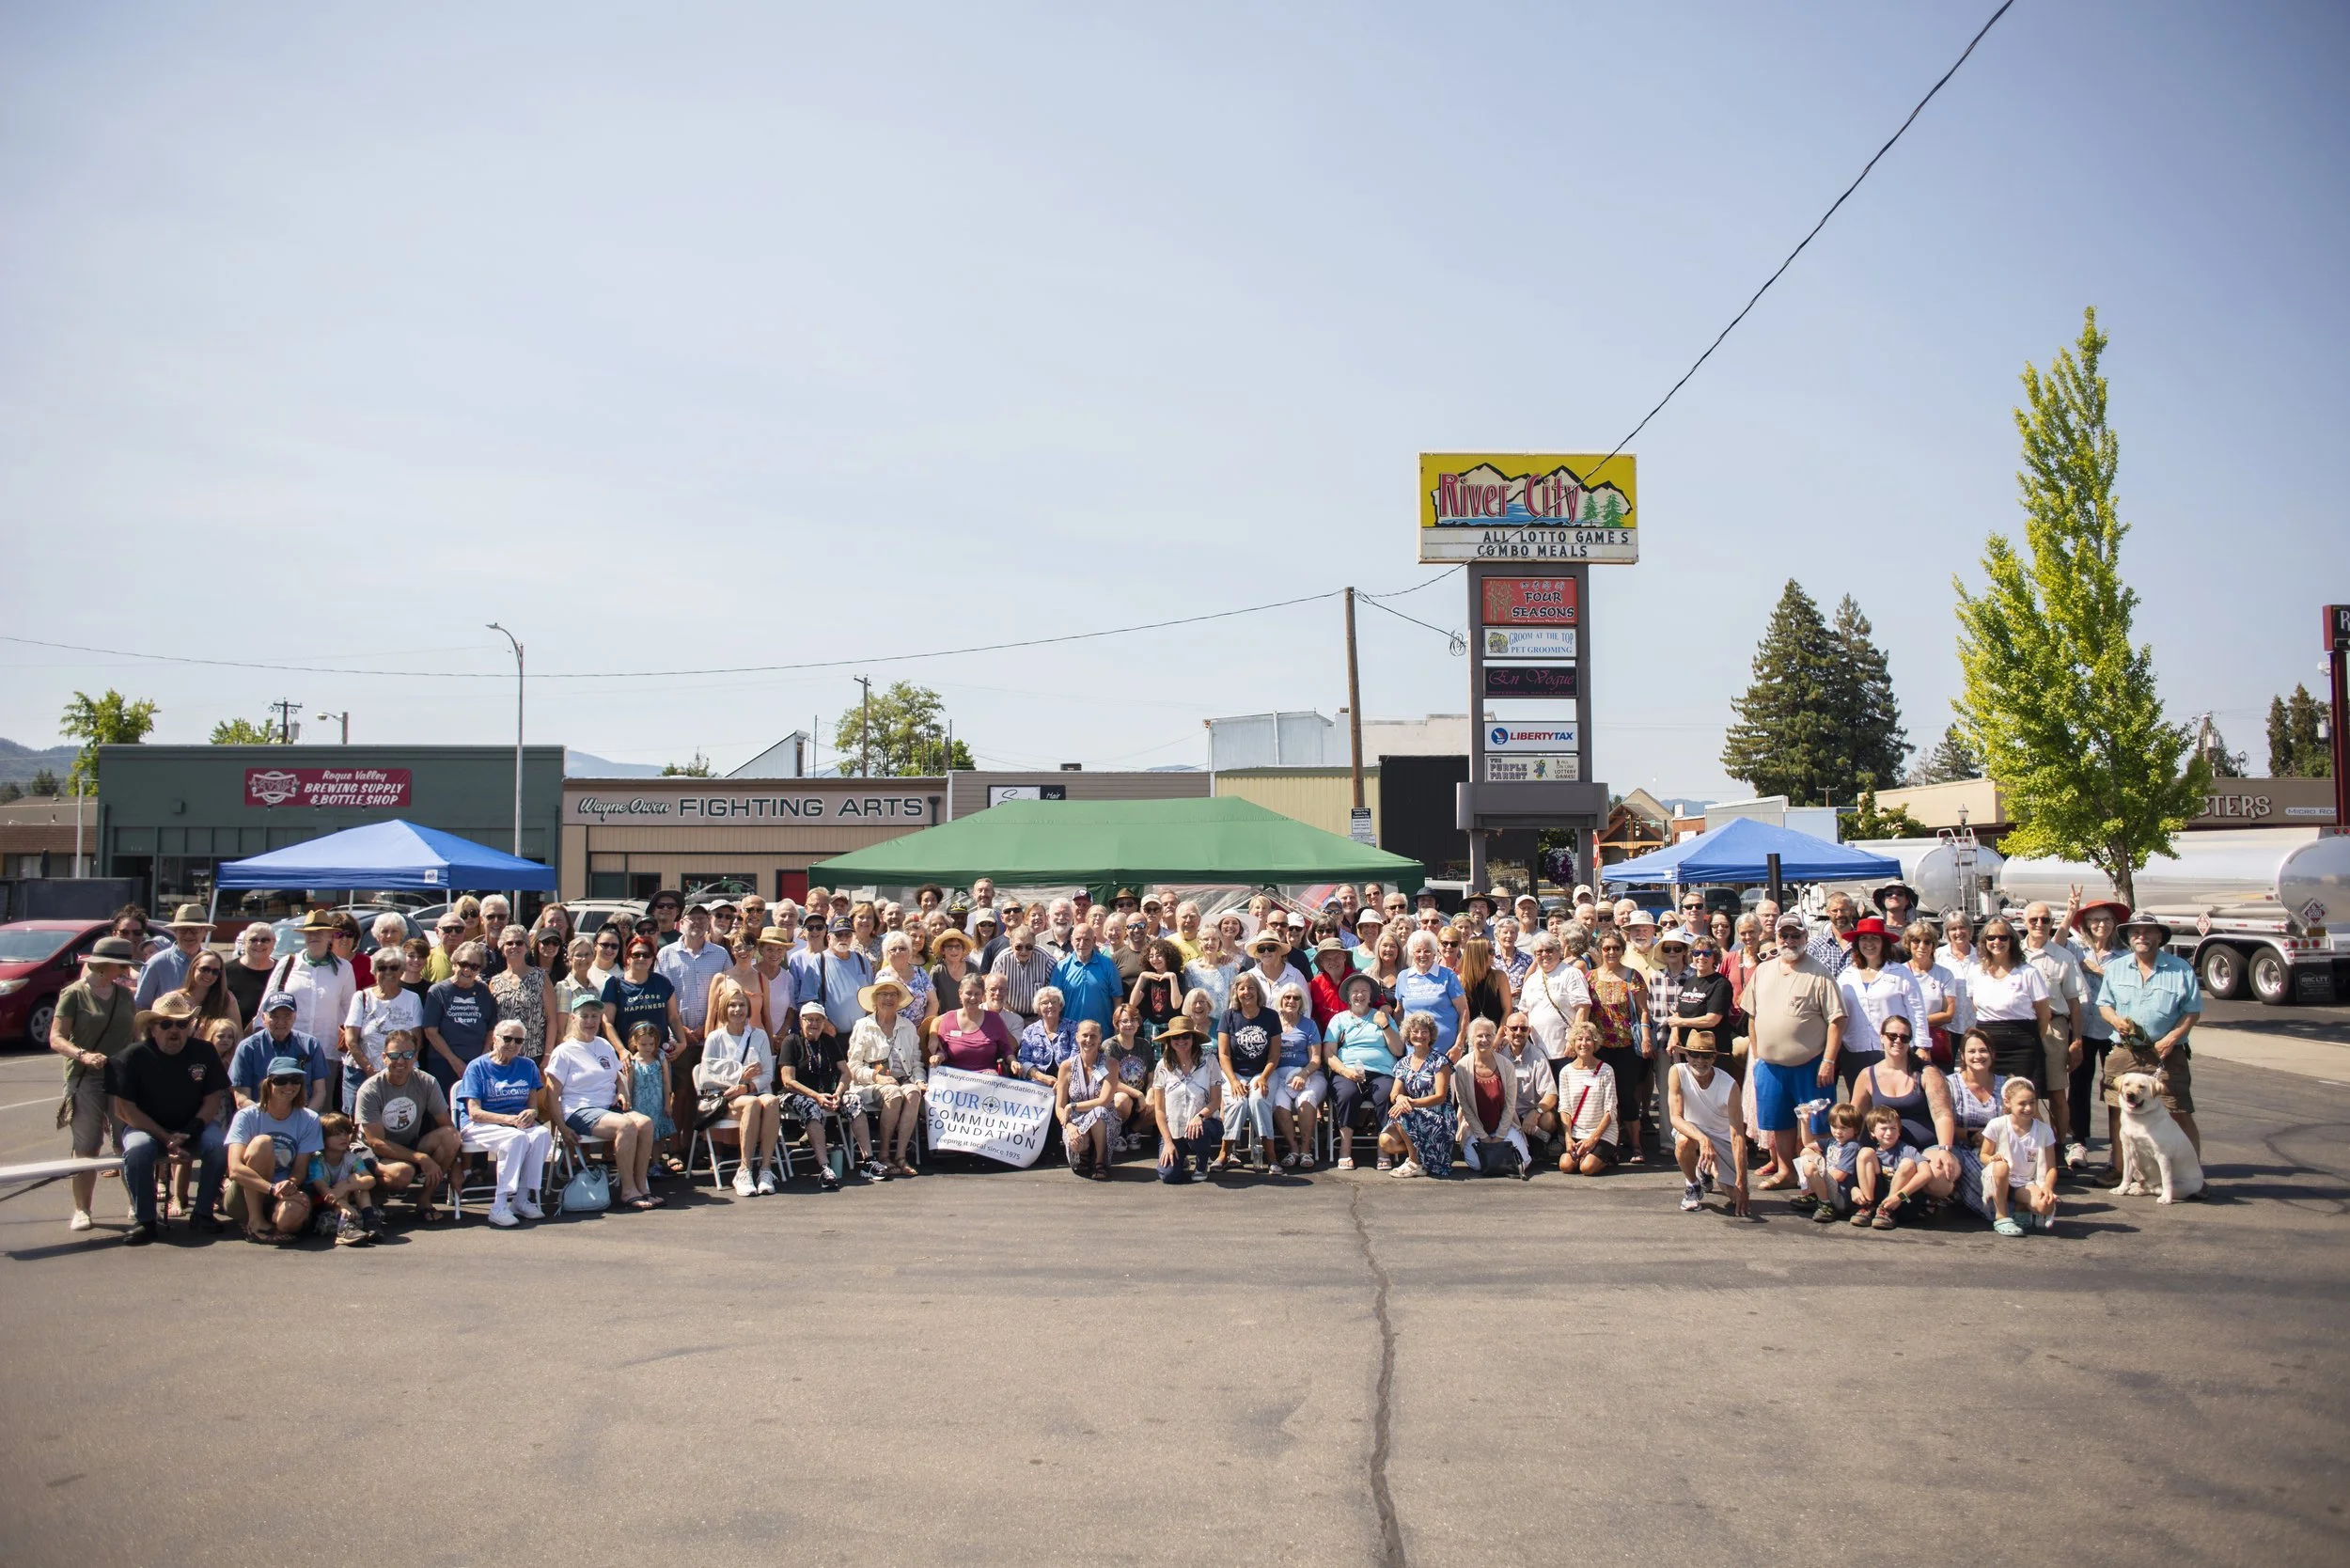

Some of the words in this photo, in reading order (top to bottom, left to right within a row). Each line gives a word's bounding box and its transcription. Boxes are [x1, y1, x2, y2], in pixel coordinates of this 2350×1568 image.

[1438, 473, 1512, 517] River
[1524, 473, 1581, 524] City
[1483, 531, 1509, 542] ALL
[1520, 531, 1566, 542] LOTTO
[1477, 545, 1529, 557] COMBO
[1537, 545, 1588, 557] MEALS
[1525, 591, 1562, 604] FOUR
[1512, 606, 1574, 619] SEASONS
[1509, 632, 1533, 646] GROOM
[1546, 632, 1559, 640] THE
[1561, 632, 1574, 645] TOP
[1488, 668, 1519, 685] En
[1526, 668, 1575, 690] Vogue
[1490, 763, 1528, 772] PURPLE
[322, 770, 352, 782] Rogue
[355, 770, 387, 782] Valley
[1490, 772, 1528, 780] PARROT
[304, 783, 358, 793] BREWING
[360, 783, 405, 793] SUPPLY
[310, 795, 318, 805] &
[320, 794, 363, 805] BOTTLE
[366, 794, 399, 805] SHOP
[577, 798, 628, 822] Wayne
[628, 797, 671, 814] Owen
[679, 797, 824, 818] FIGHTING
[837, 797, 924, 818] ARTS
[2198, 795, 2272, 820] STERS
[627, 994, 661, 1003] CHOOSE
[932, 1089, 979, 1110] FOUR
[1003, 1100, 1046, 1121] WAY
[929, 1106, 1041, 1137] COMMUNITY
[928, 1119, 1036, 1150] FOUNDATION
[970, 1141, 986, 1150] local
[987, 1146, 1005, 1155] since
[1006, 1151, 1021, 1160] 1975
